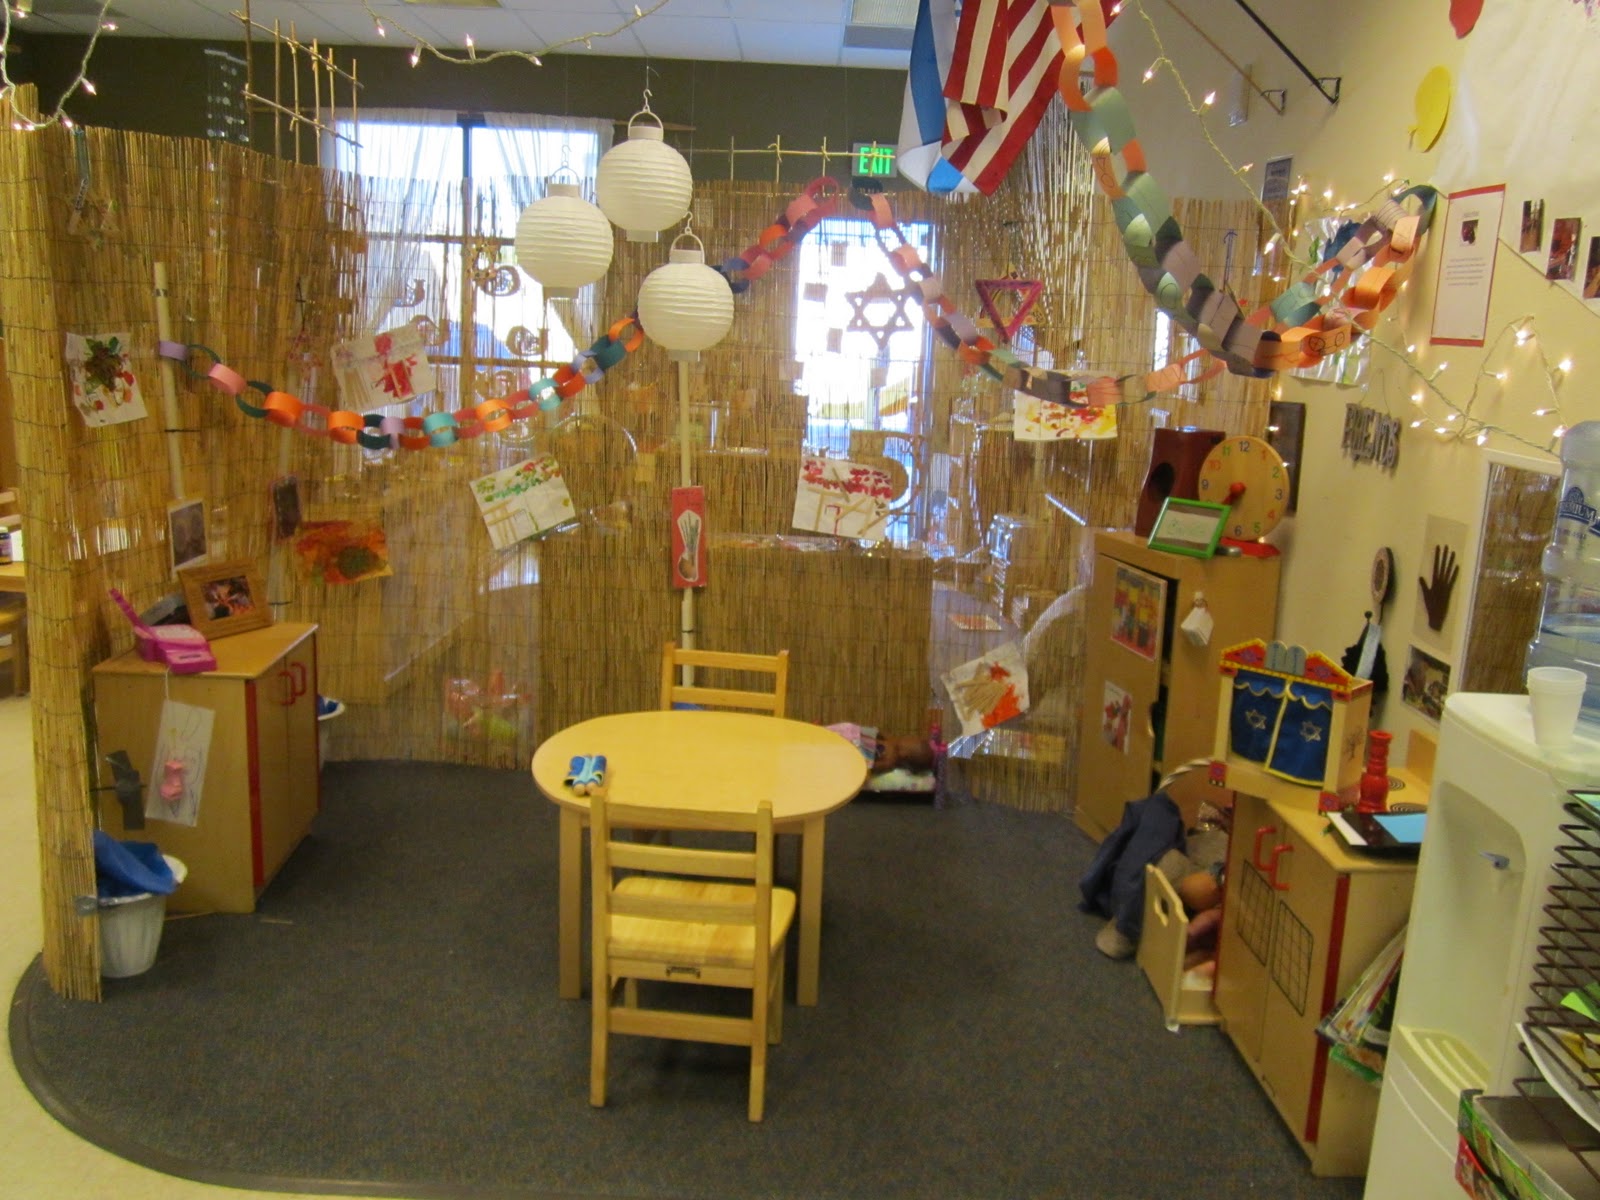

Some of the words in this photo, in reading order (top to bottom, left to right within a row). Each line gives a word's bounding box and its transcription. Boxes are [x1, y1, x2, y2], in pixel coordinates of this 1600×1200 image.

[859, 147, 893, 175] EXIT
[1240, 441, 1250, 452] 12
[1272, 466, 1280, 479] 2
[1201, 479, 1209, 490] 9
[1275, 488, 1283, 500] 3
[1267, 509, 1275, 519] 4
[1234, 525, 1242, 536] 6
[1253, 522, 1262, 533] 5
